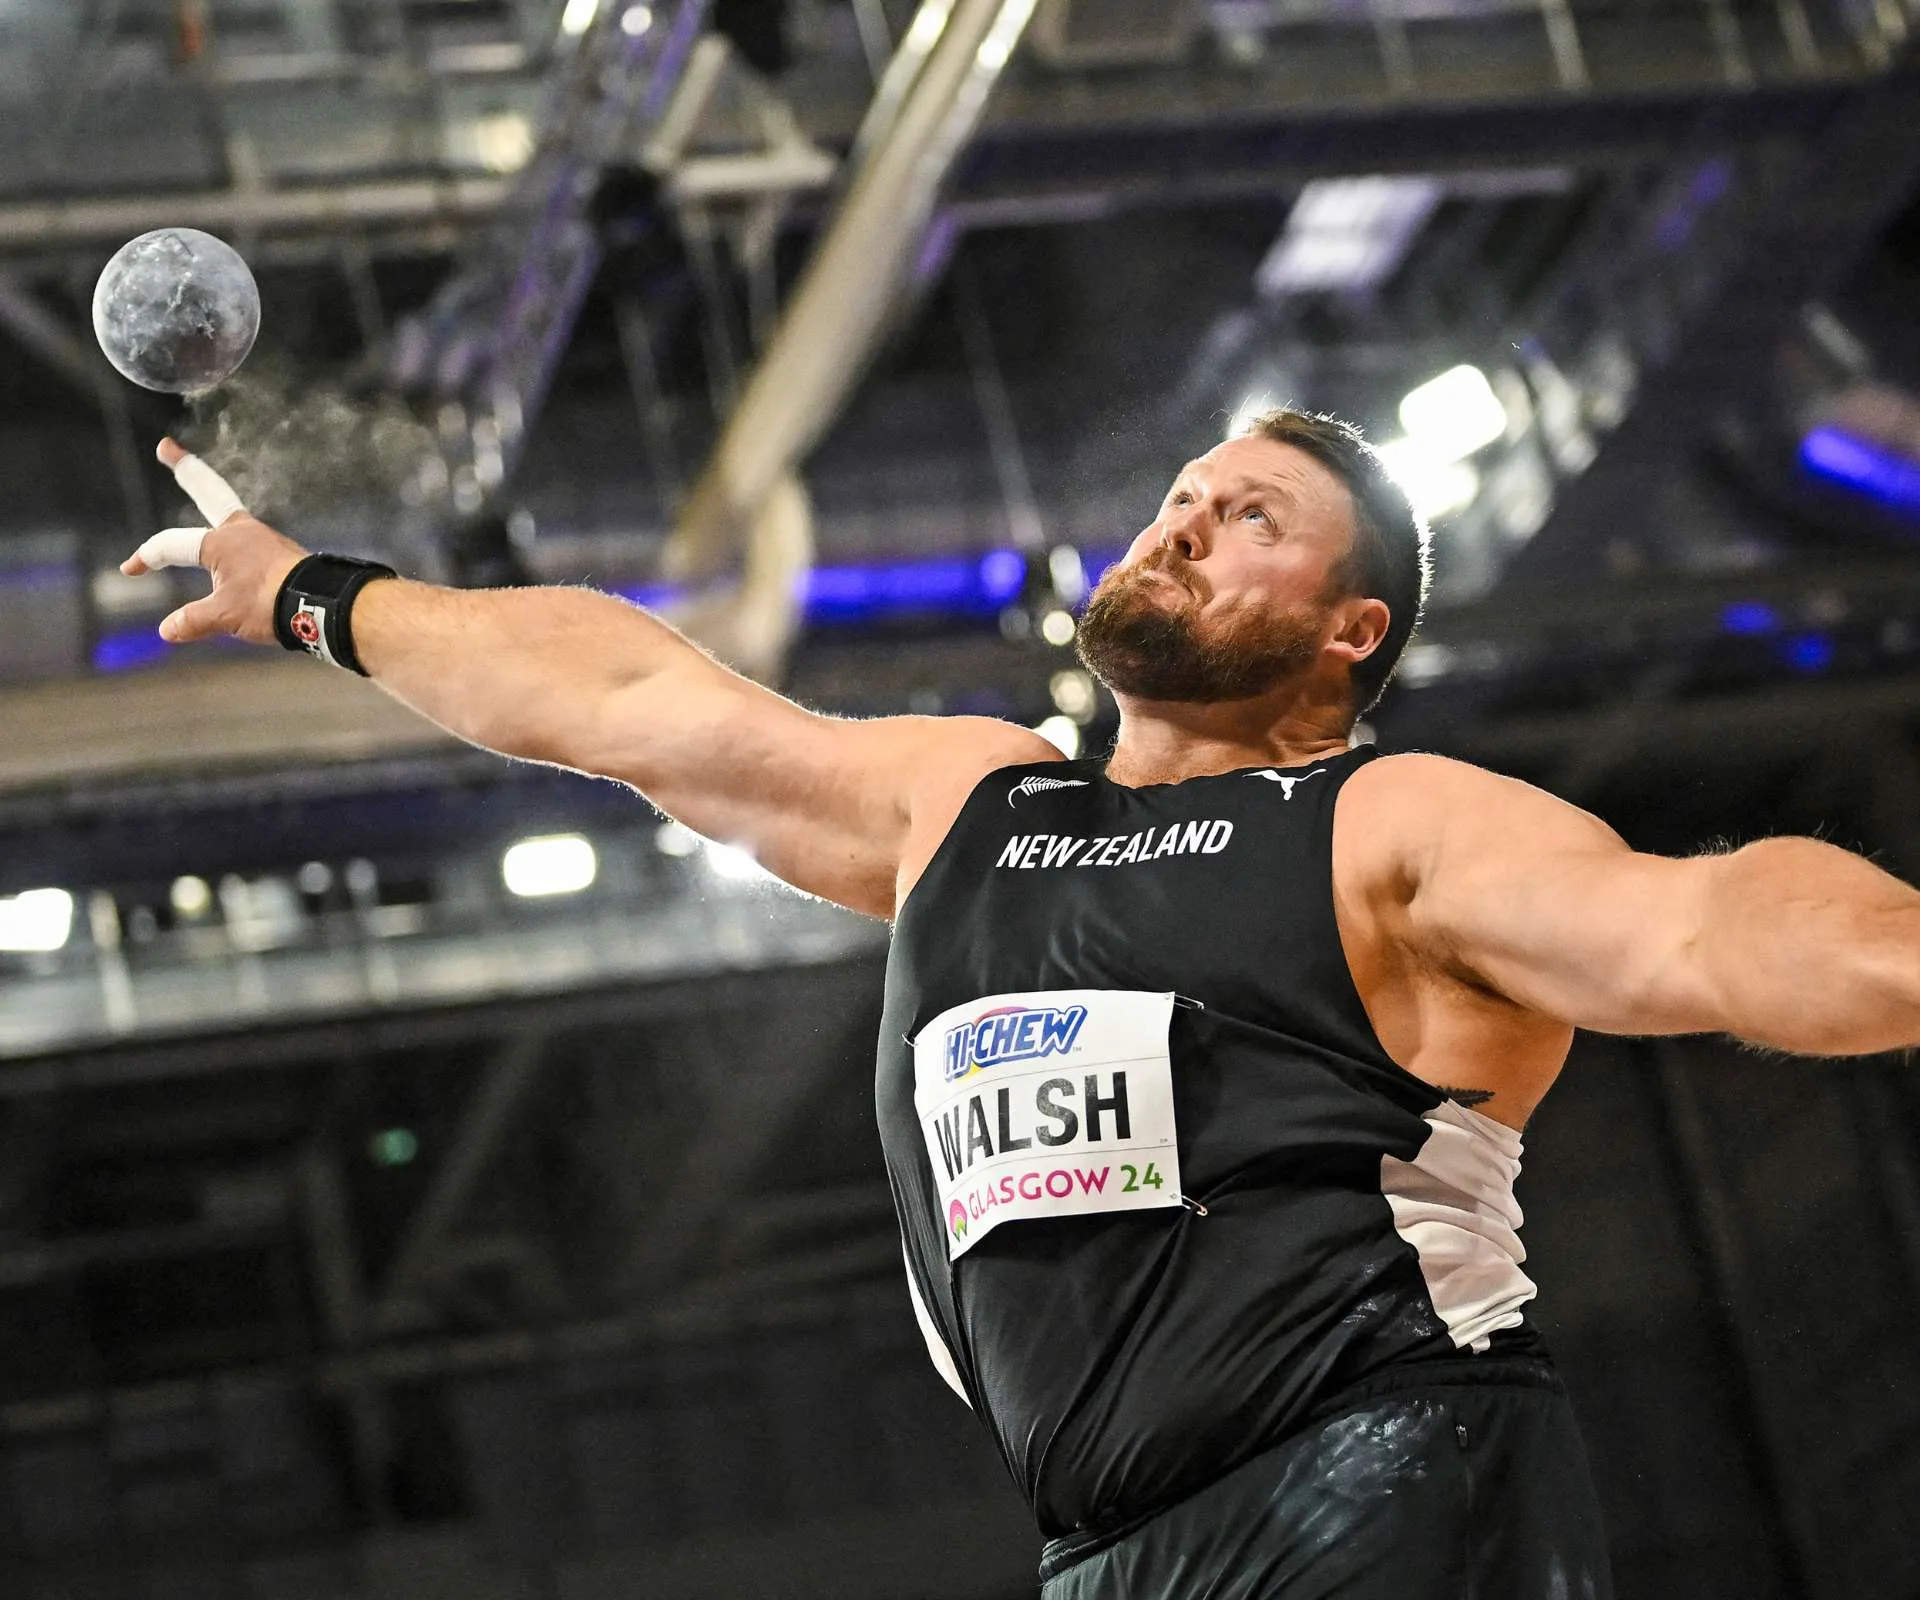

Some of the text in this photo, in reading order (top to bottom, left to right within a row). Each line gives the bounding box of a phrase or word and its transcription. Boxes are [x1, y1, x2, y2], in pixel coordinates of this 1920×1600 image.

[995, 819, 1234, 869] NEW ZEALAND
[944, 1005, 1089, 1083] HI-CHEW
[934, 1071, 1132, 1182] WALSH
[968, 1162, 1164, 1220] GLASGOW 24
